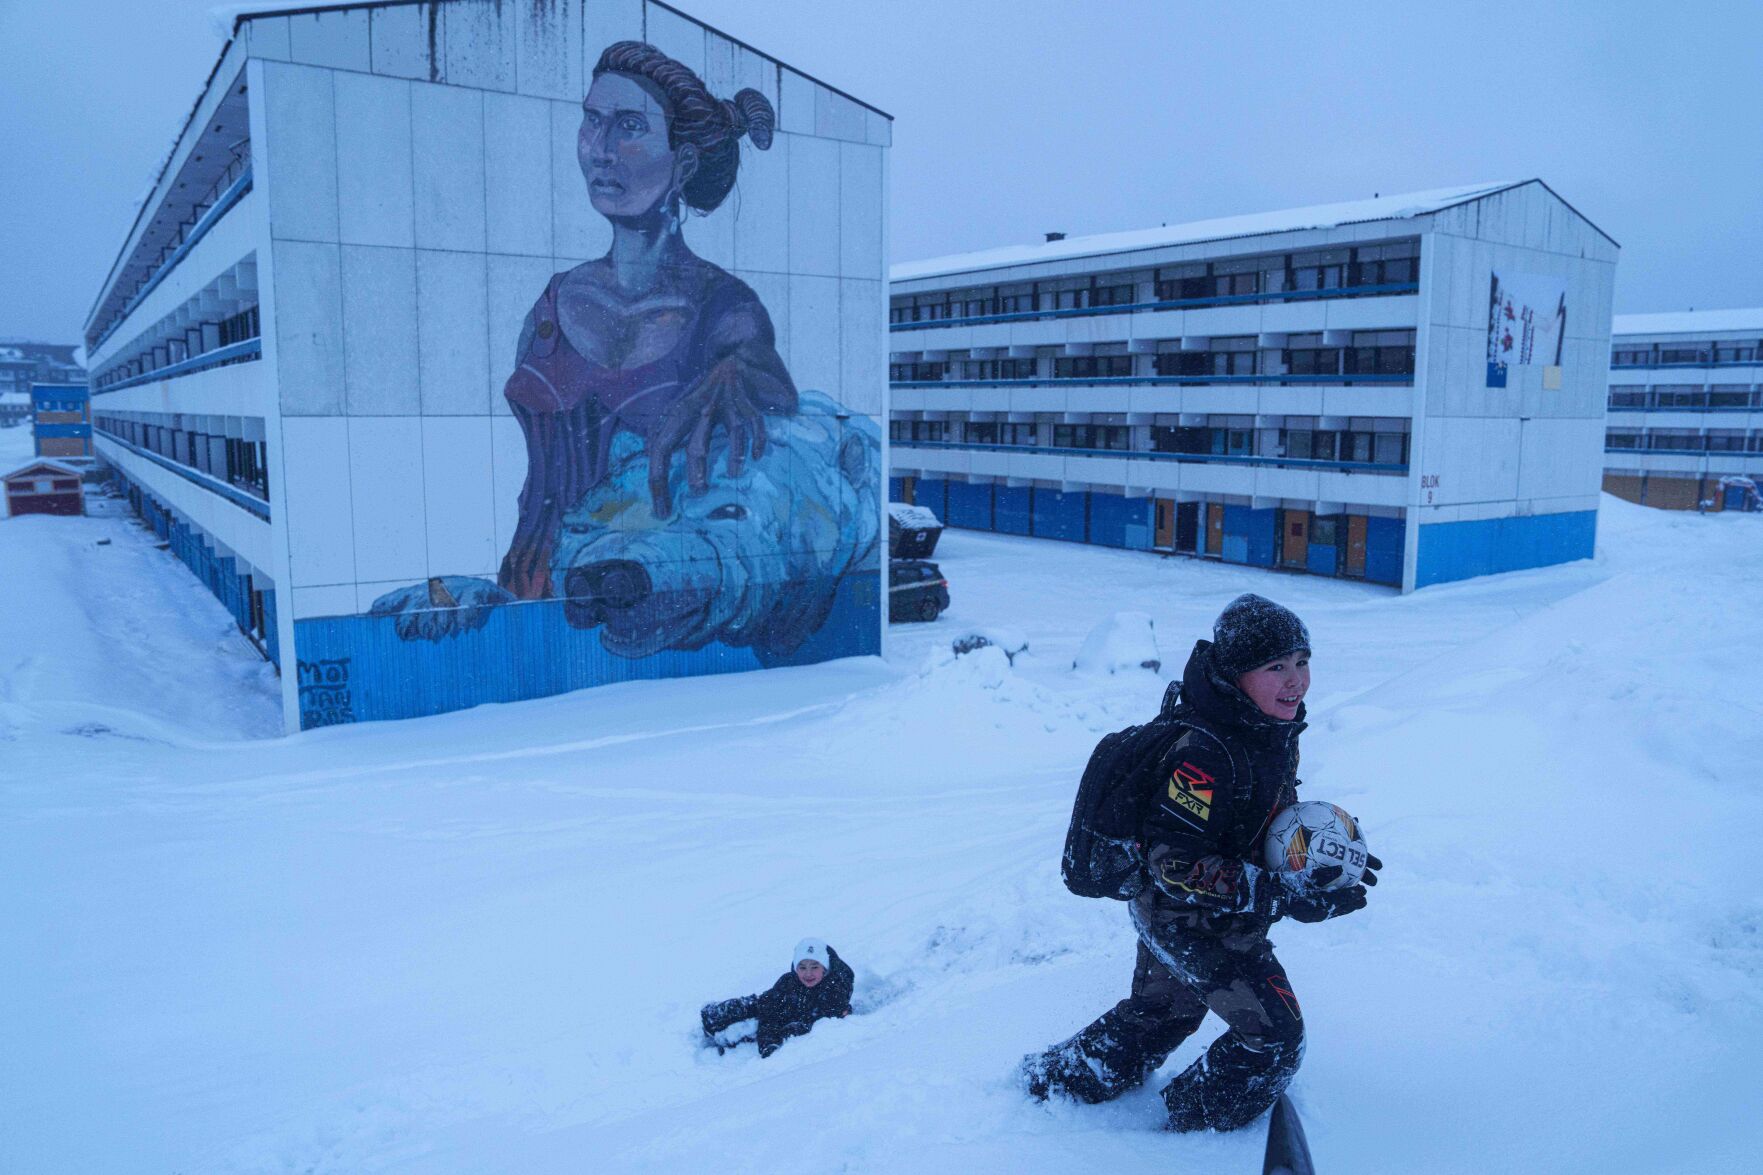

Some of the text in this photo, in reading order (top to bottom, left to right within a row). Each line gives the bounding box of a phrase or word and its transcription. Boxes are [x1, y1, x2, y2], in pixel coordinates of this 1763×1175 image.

[1421, 474, 1440, 488] BLOK
[1427, 490, 1433, 504] 9
[1174, 791, 1204, 814] FXR
[1316, 838, 1366, 868] SELECT
